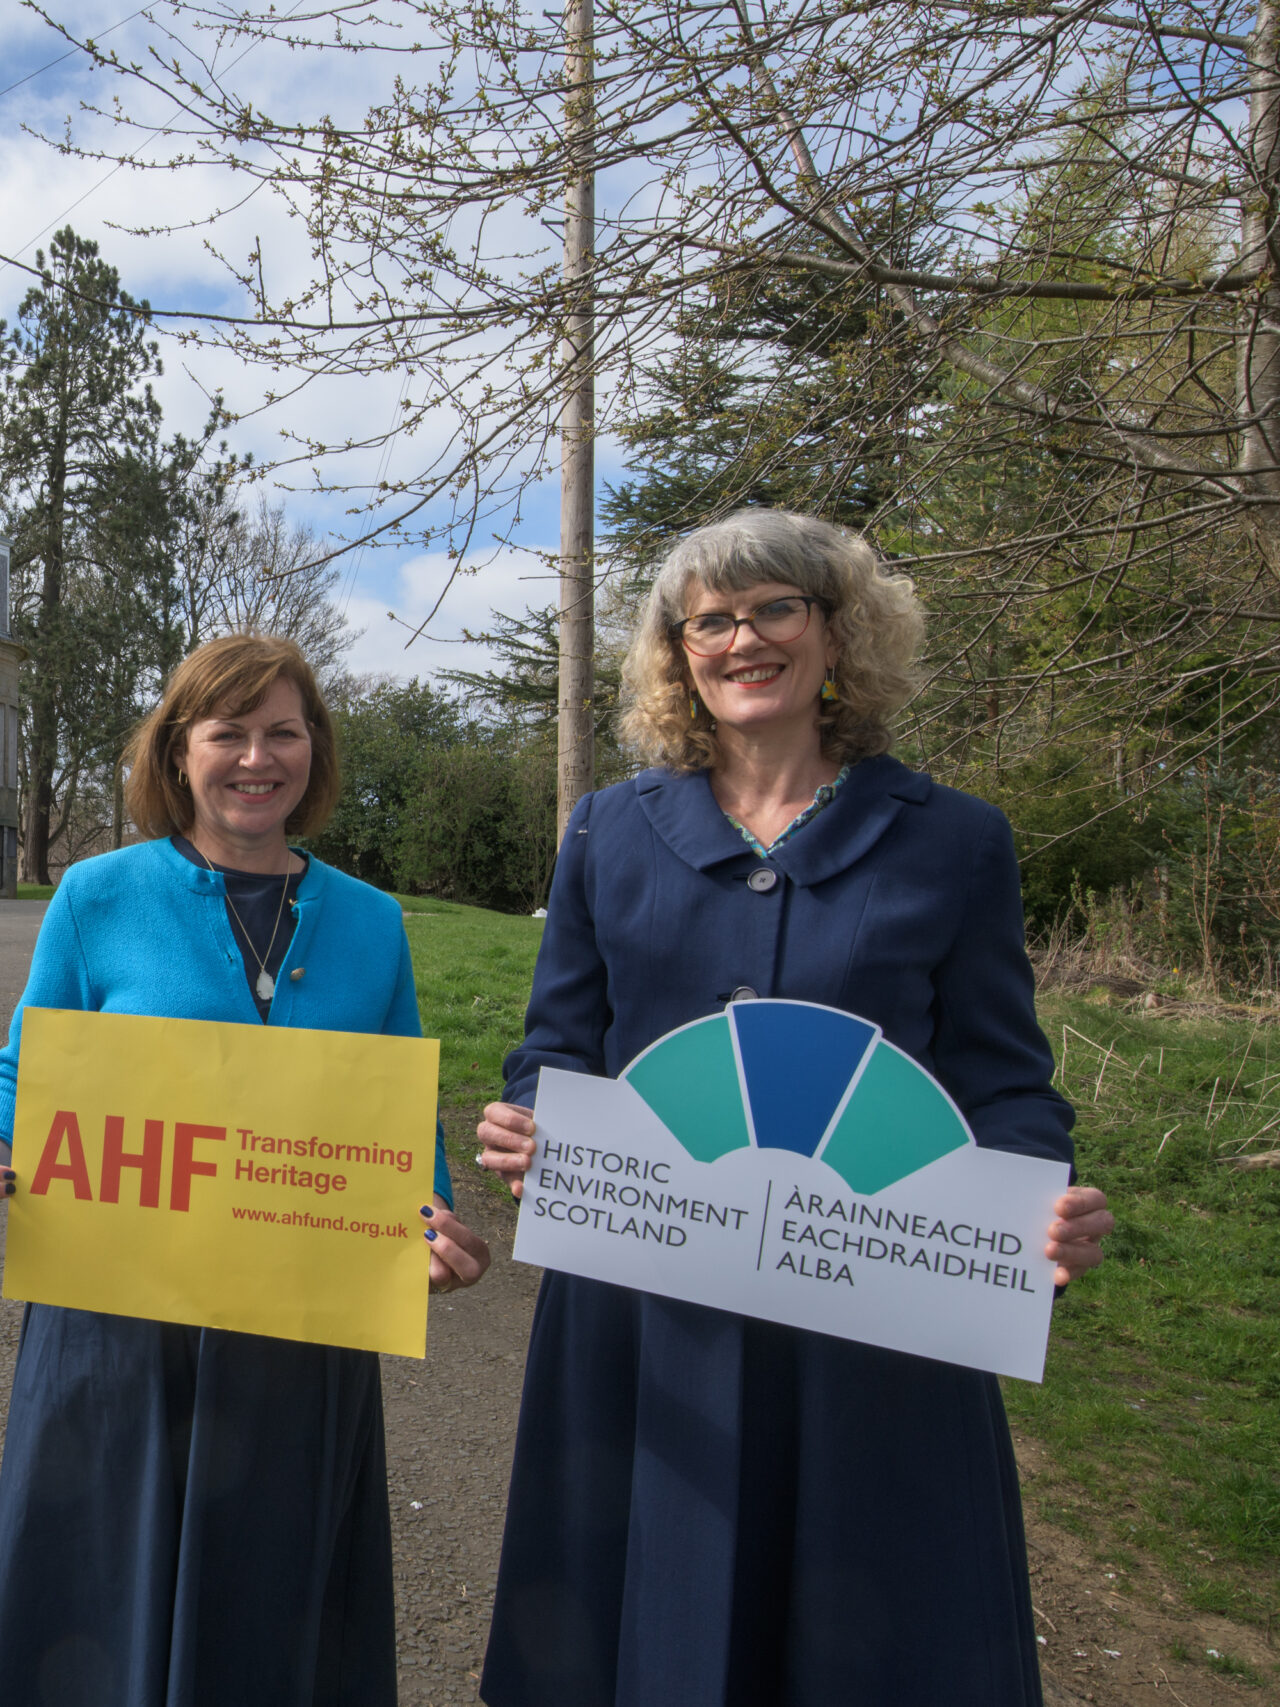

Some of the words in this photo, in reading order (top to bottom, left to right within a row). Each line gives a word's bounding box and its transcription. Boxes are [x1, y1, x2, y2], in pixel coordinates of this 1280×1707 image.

[30, 1110, 227, 1212] AHF
[236, 1128, 413, 1173] Transforming
[542, 1139, 671, 1184] HISTORIC
[234, 1159, 348, 1194] Heritage
[538, 1167, 749, 1230] ENVIRONMENT
[232, 1207, 410, 1239] www.ahfund.org.uk
[534, 1196, 687, 1247] SCOTLAND
[784, 1184, 1023, 1256] ÀRAINNEACHD
[775, 1250, 855, 1287] ALBA
[781, 1219, 1036, 1294] EACHDRAIDHEIL
